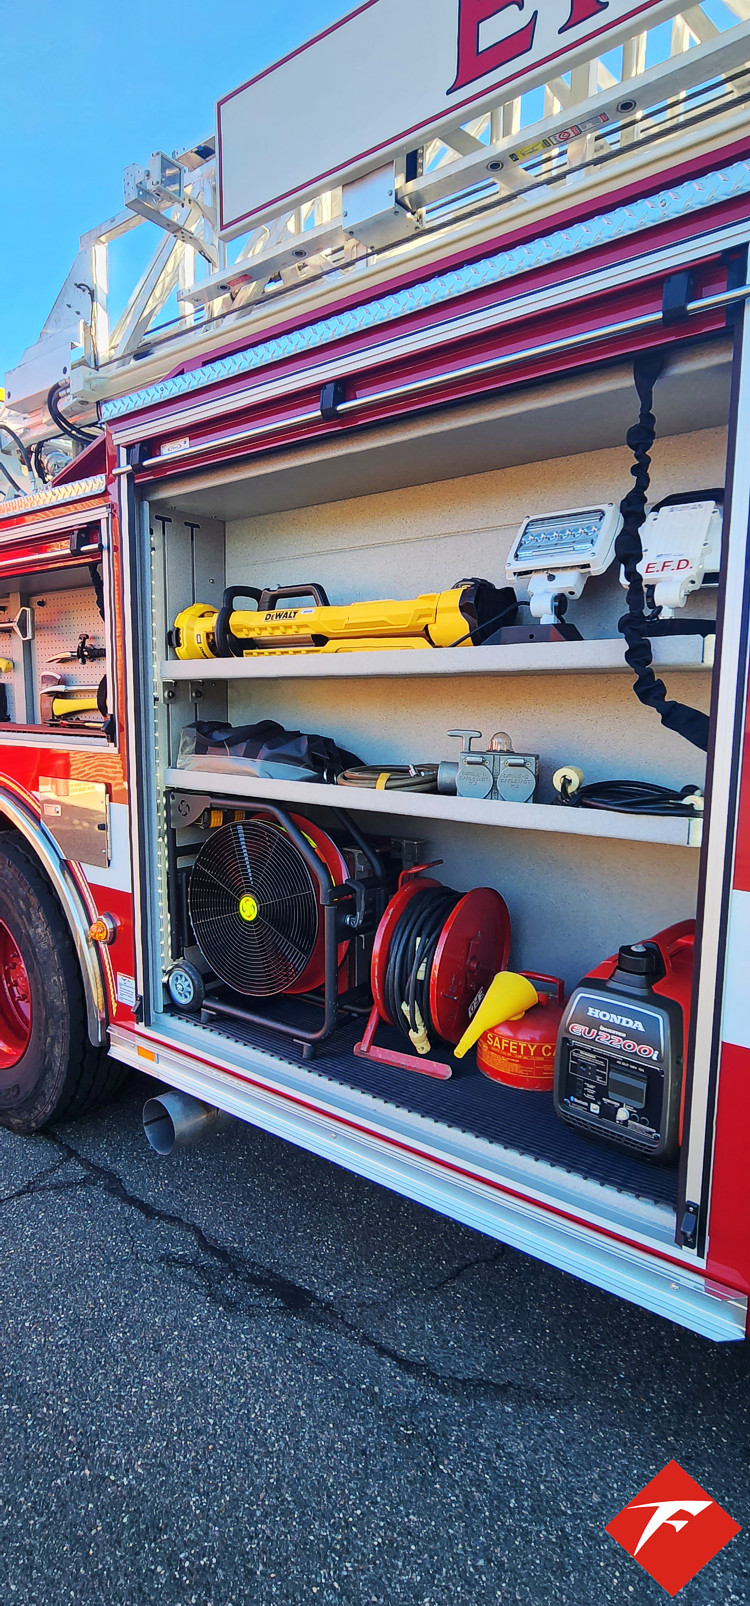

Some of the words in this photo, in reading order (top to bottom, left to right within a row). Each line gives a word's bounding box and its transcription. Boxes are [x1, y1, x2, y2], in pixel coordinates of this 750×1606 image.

[645, 558, 693, 574] E.F.D.
[586, 1006, 646, 1033] HONDA
[486, 1033, 538, 1056] SAFETY
[568, 1023, 660, 1061] EU2200i
